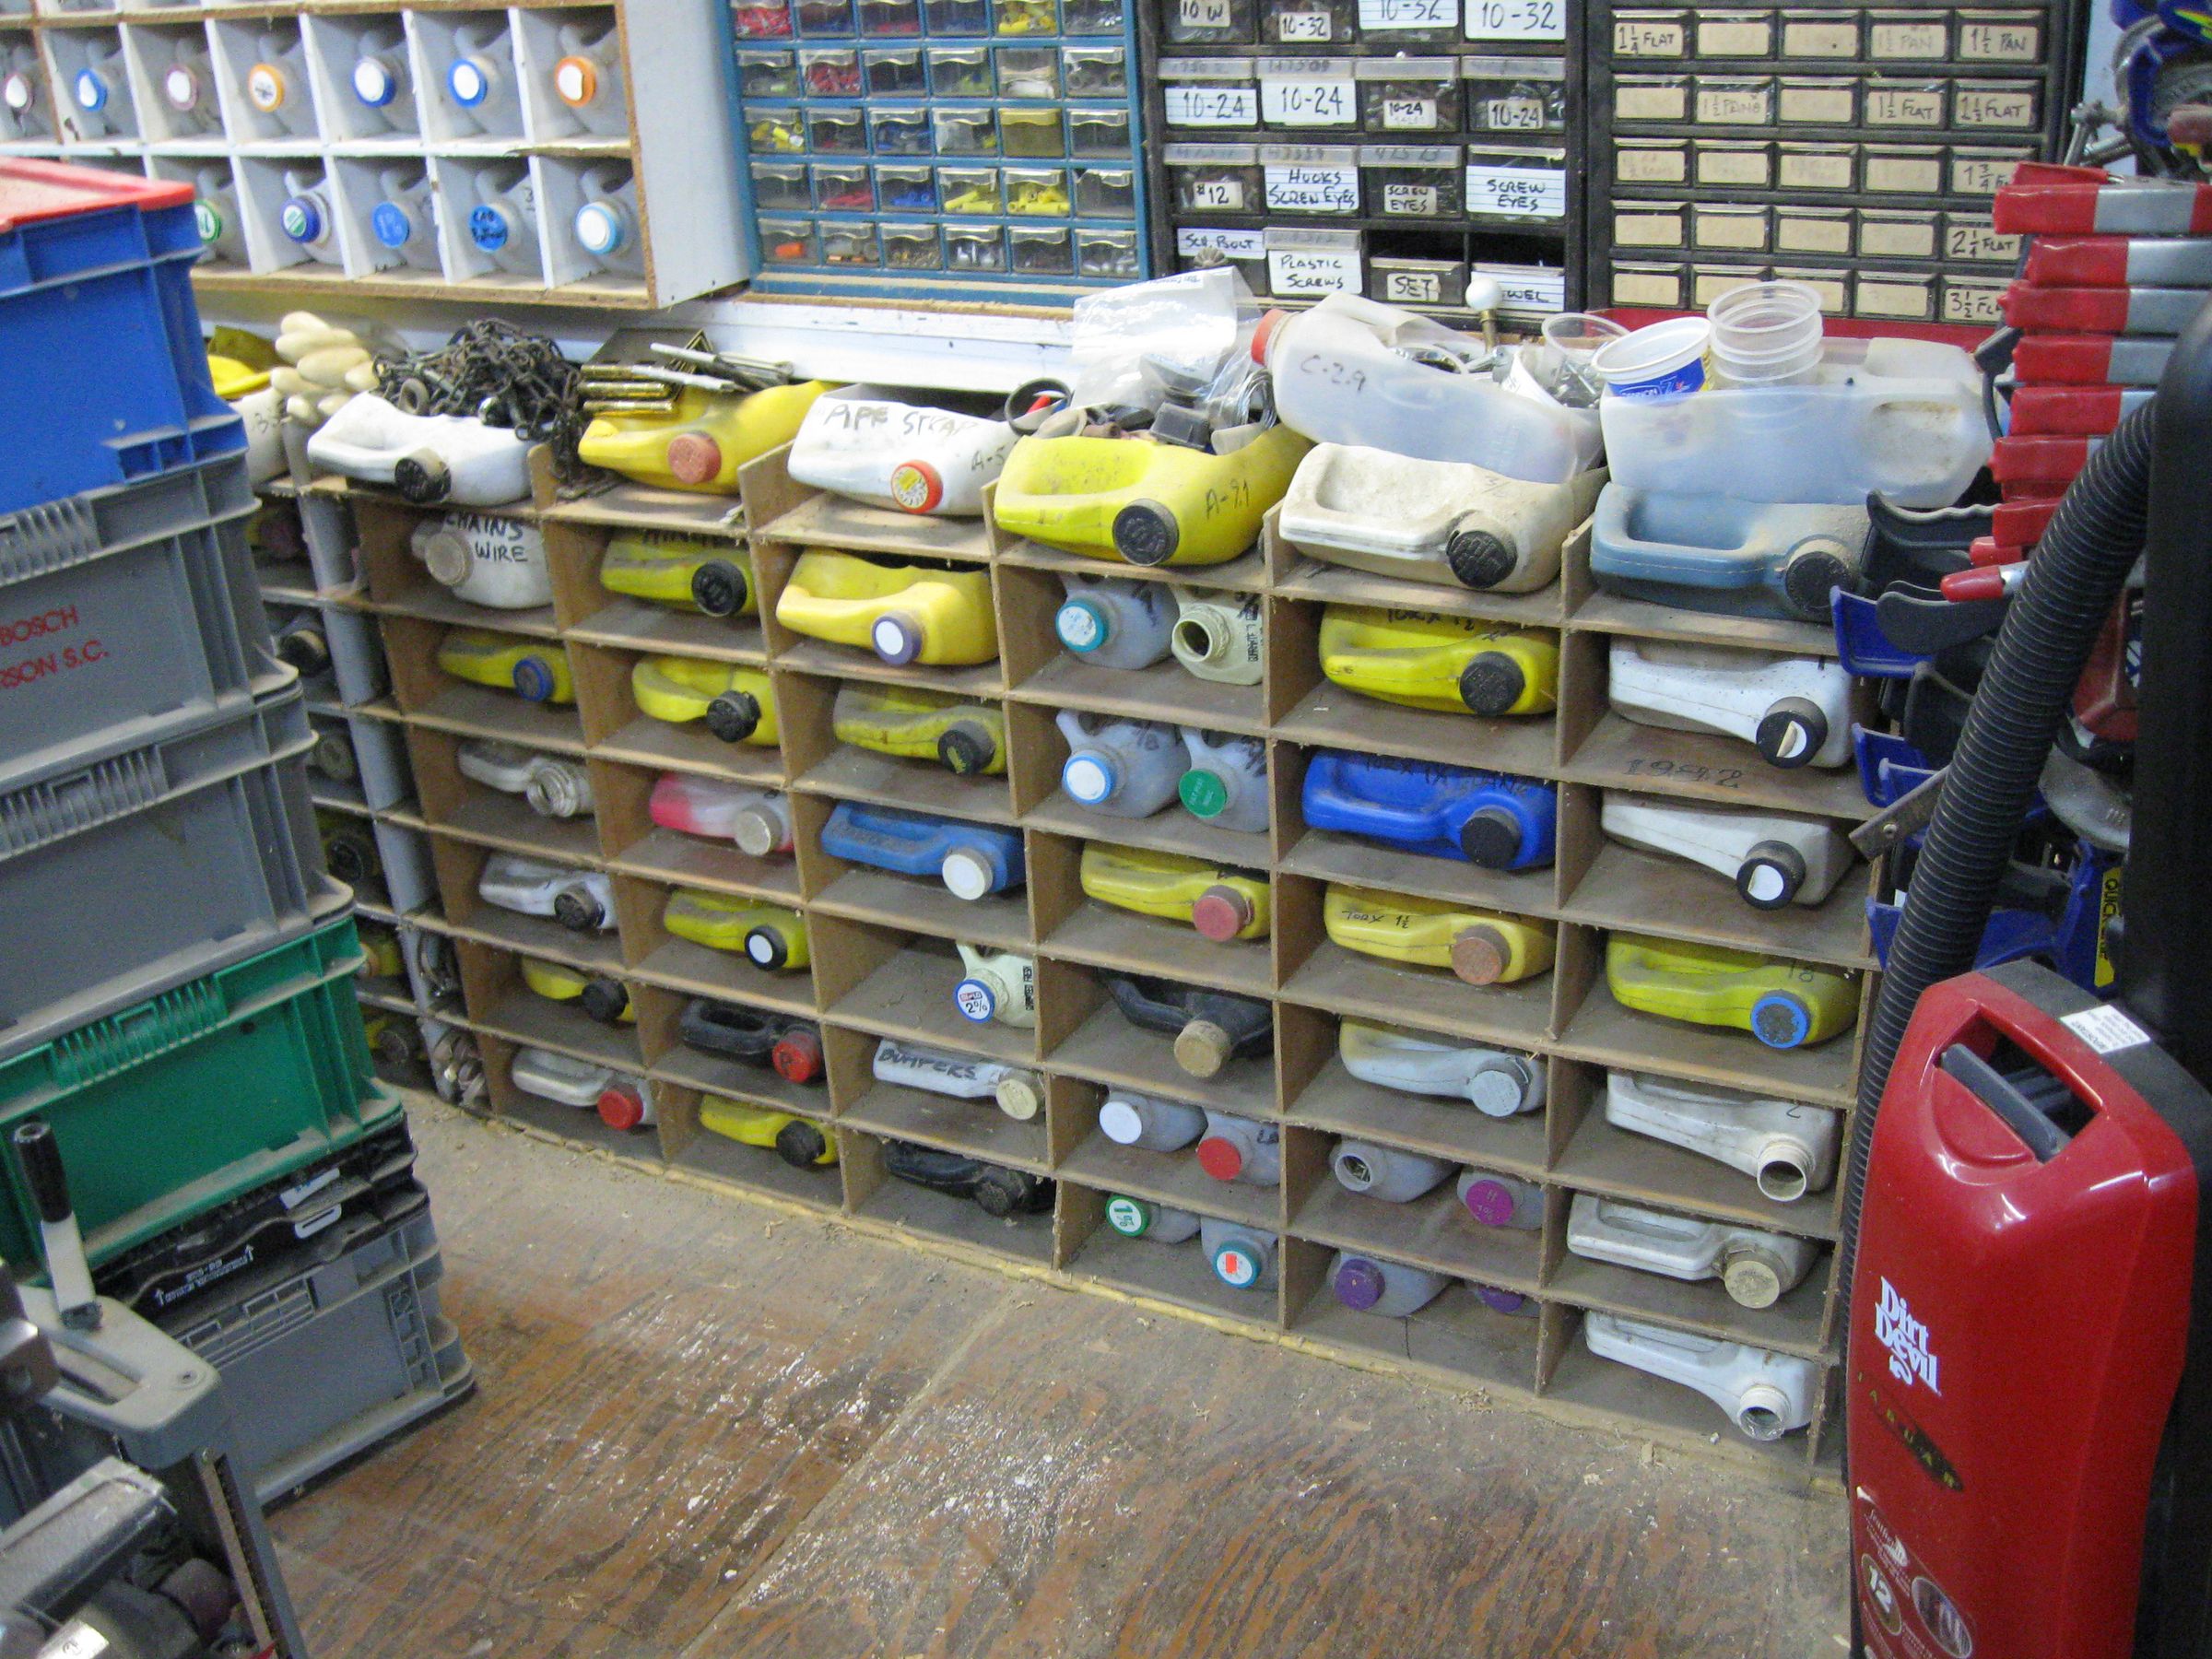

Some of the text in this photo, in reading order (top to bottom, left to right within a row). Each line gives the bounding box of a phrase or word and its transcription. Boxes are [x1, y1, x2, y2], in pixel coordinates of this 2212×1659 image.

[1282, 16, 1327, 37] 10-32
[1481, 2, 1557, 30] 10-32
[1183, 90, 1245, 119] 10-24
[1281, 86, 1343, 116] 10-24
[1491, 103, 1542, 128] 10-24
[1487, 179, 1546, 194] SCREW
[1391, 199, 1428, 213] EYES
[1498, 194, 1539, 212] EYES
[1281, 254, 1343, 269] PLASTIC
[1288, 275, 1344, 288] SCREWS
[1394, 276, 1434, 297] SET
[475, 541, 528, 562] WIRE
[1342, 910, 1385, 924] TORX
[965, 999, 988, 1014] 2%
[1880, 1276, 1929, 1357] Dirt
[1875, 1301, 1938, 1394] Devil
